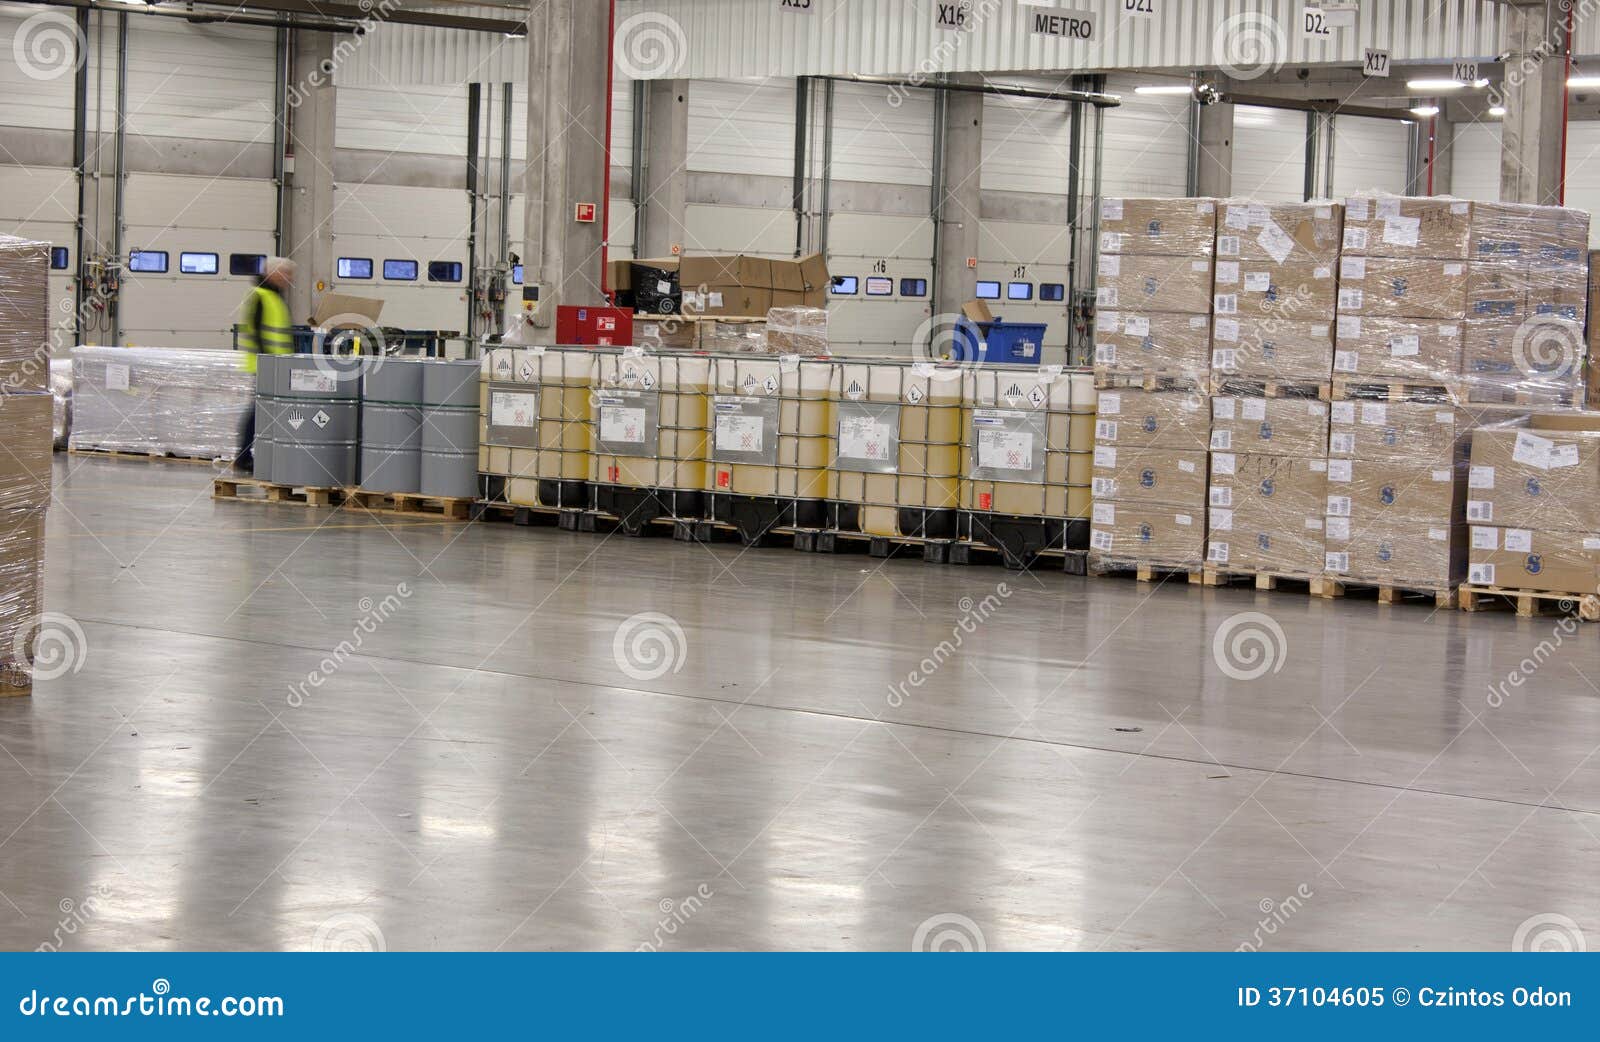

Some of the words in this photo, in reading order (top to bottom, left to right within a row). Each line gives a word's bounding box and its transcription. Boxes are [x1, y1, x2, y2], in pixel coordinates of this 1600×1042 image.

[938, 4, 965, 26] X16
[1035, 14, 1092, 39] METRO
[1366, 52, 1387, 72] X17
[1455, 63, 1476, 82] X18
